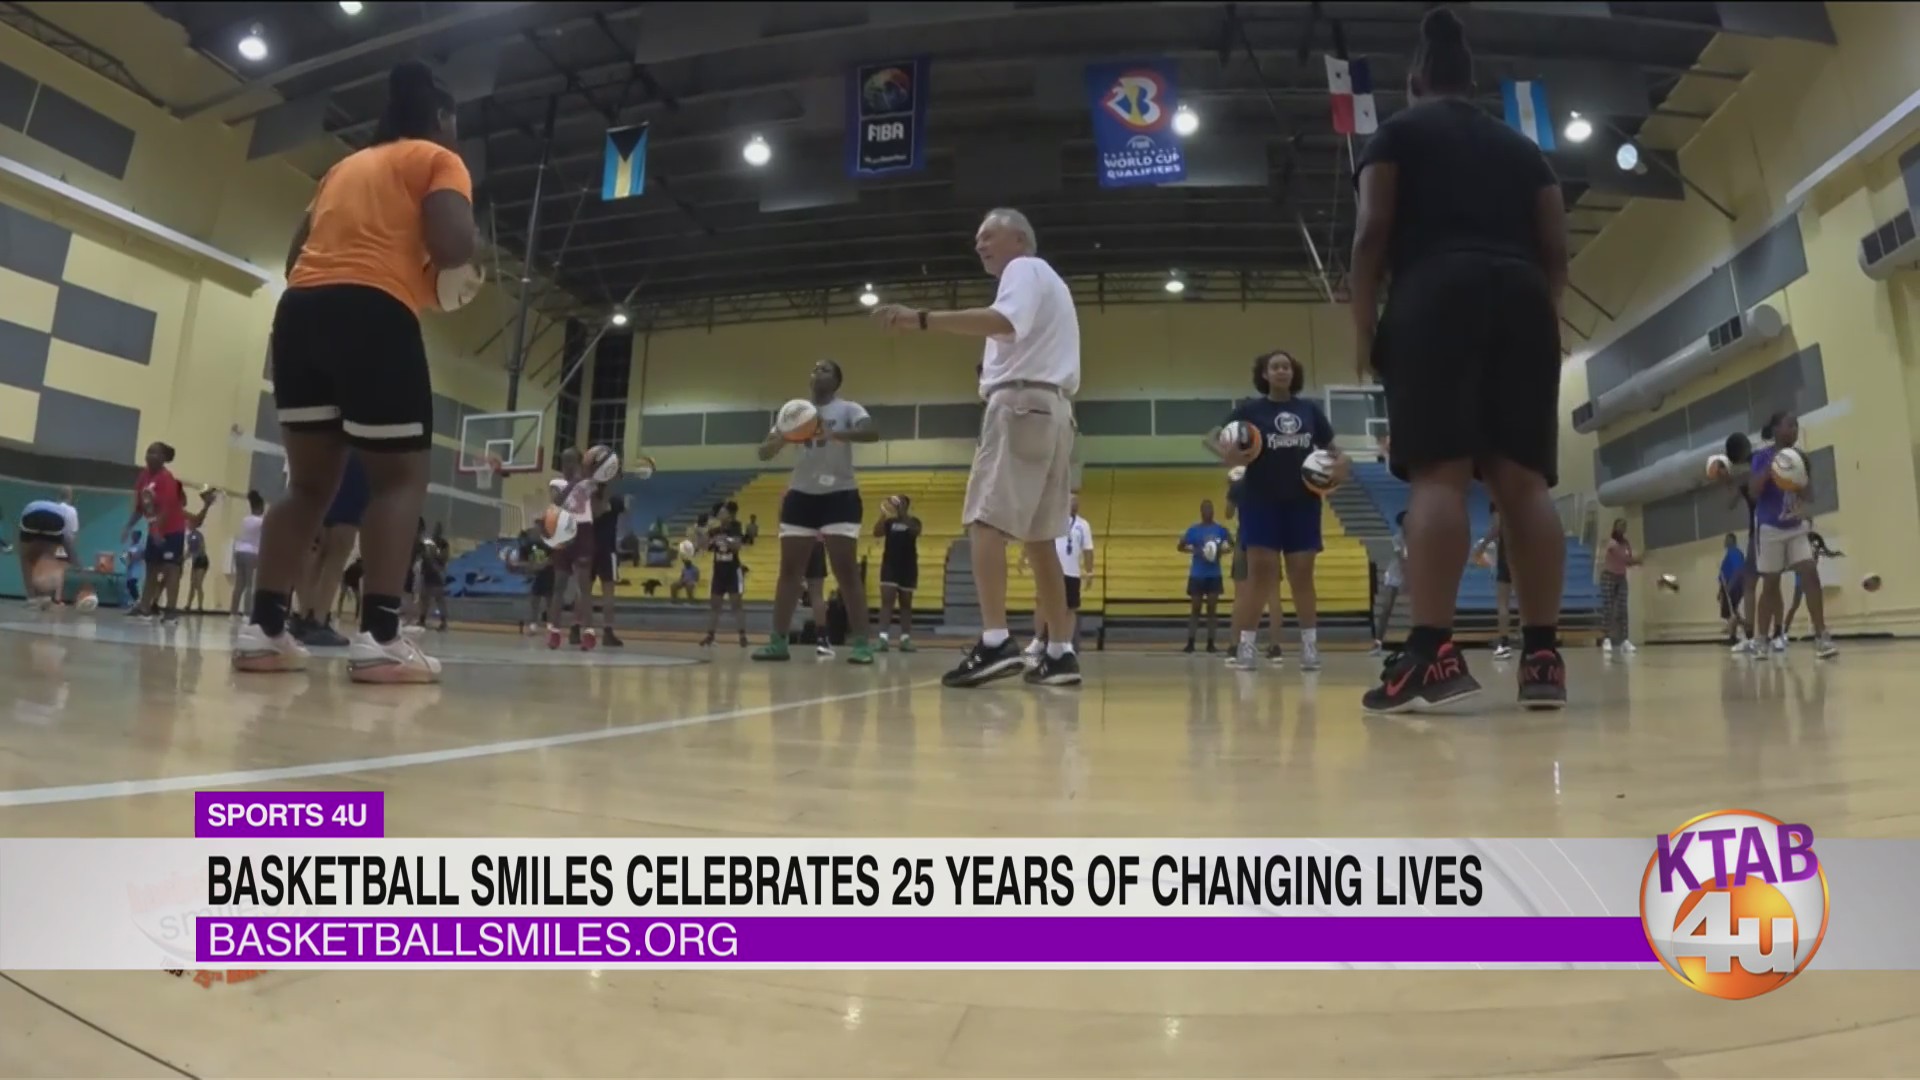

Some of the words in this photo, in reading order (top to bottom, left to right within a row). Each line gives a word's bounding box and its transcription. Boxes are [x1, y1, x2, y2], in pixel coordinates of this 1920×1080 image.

[868, 122, 904, 142] FIBA
[1104, 156, 1153, 168] WORLD
[1155, 153, 1180, 164] CUP
[1107, 164, 1181, 179] QUALIFIERS
[1422, 657, 1461, 687] AIR
